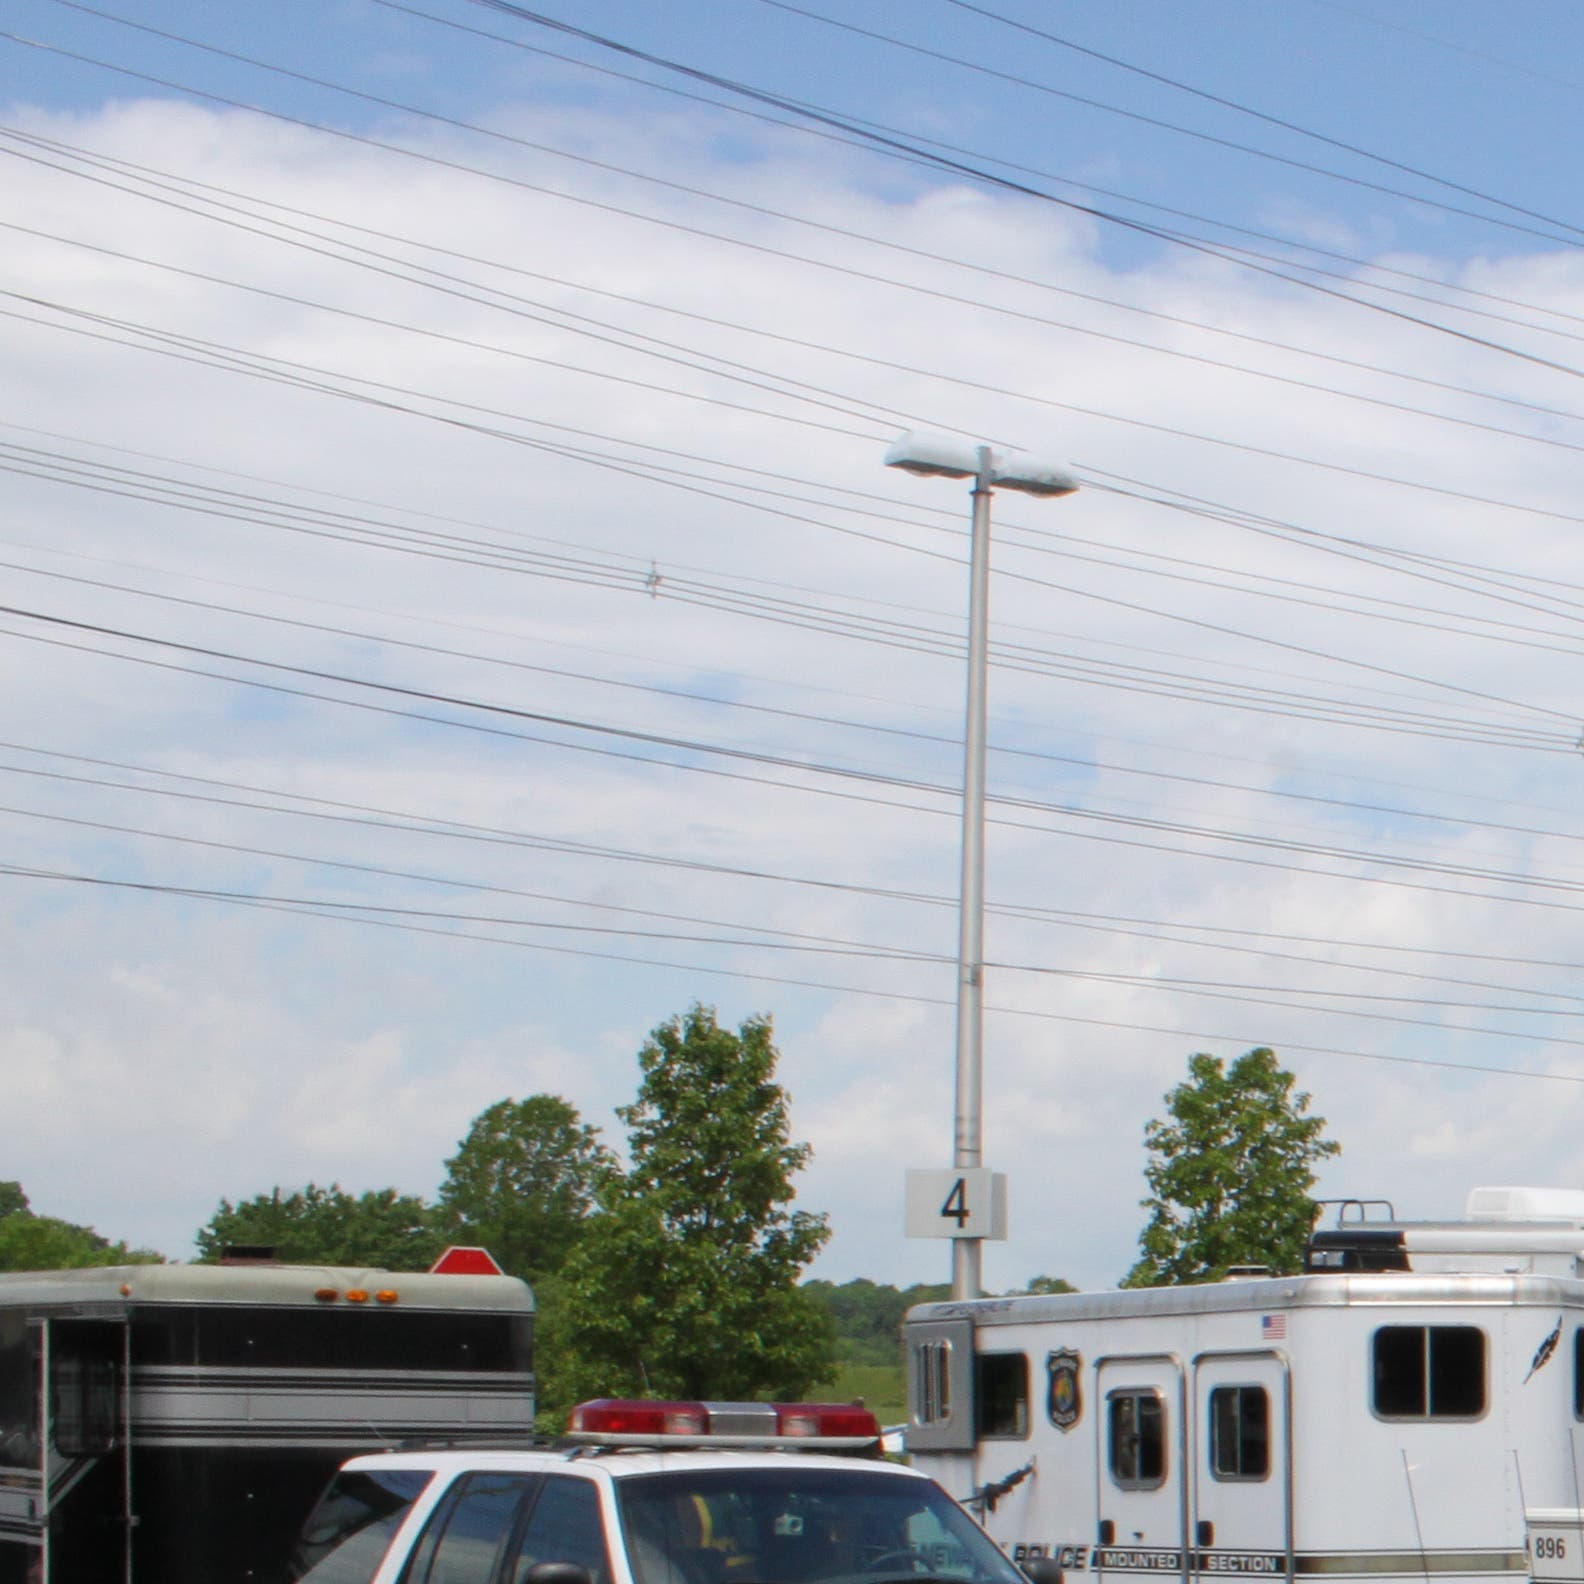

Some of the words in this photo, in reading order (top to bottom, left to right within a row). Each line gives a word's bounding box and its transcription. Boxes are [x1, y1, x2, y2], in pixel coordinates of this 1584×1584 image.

[940, 1178, 970, 1228] 4
[1536, 1537, 1565, 1559] 896
[1104, 1553, 1177, 1569] MOUNTED
[1208, 1555, 1276, 1571] SECTION
